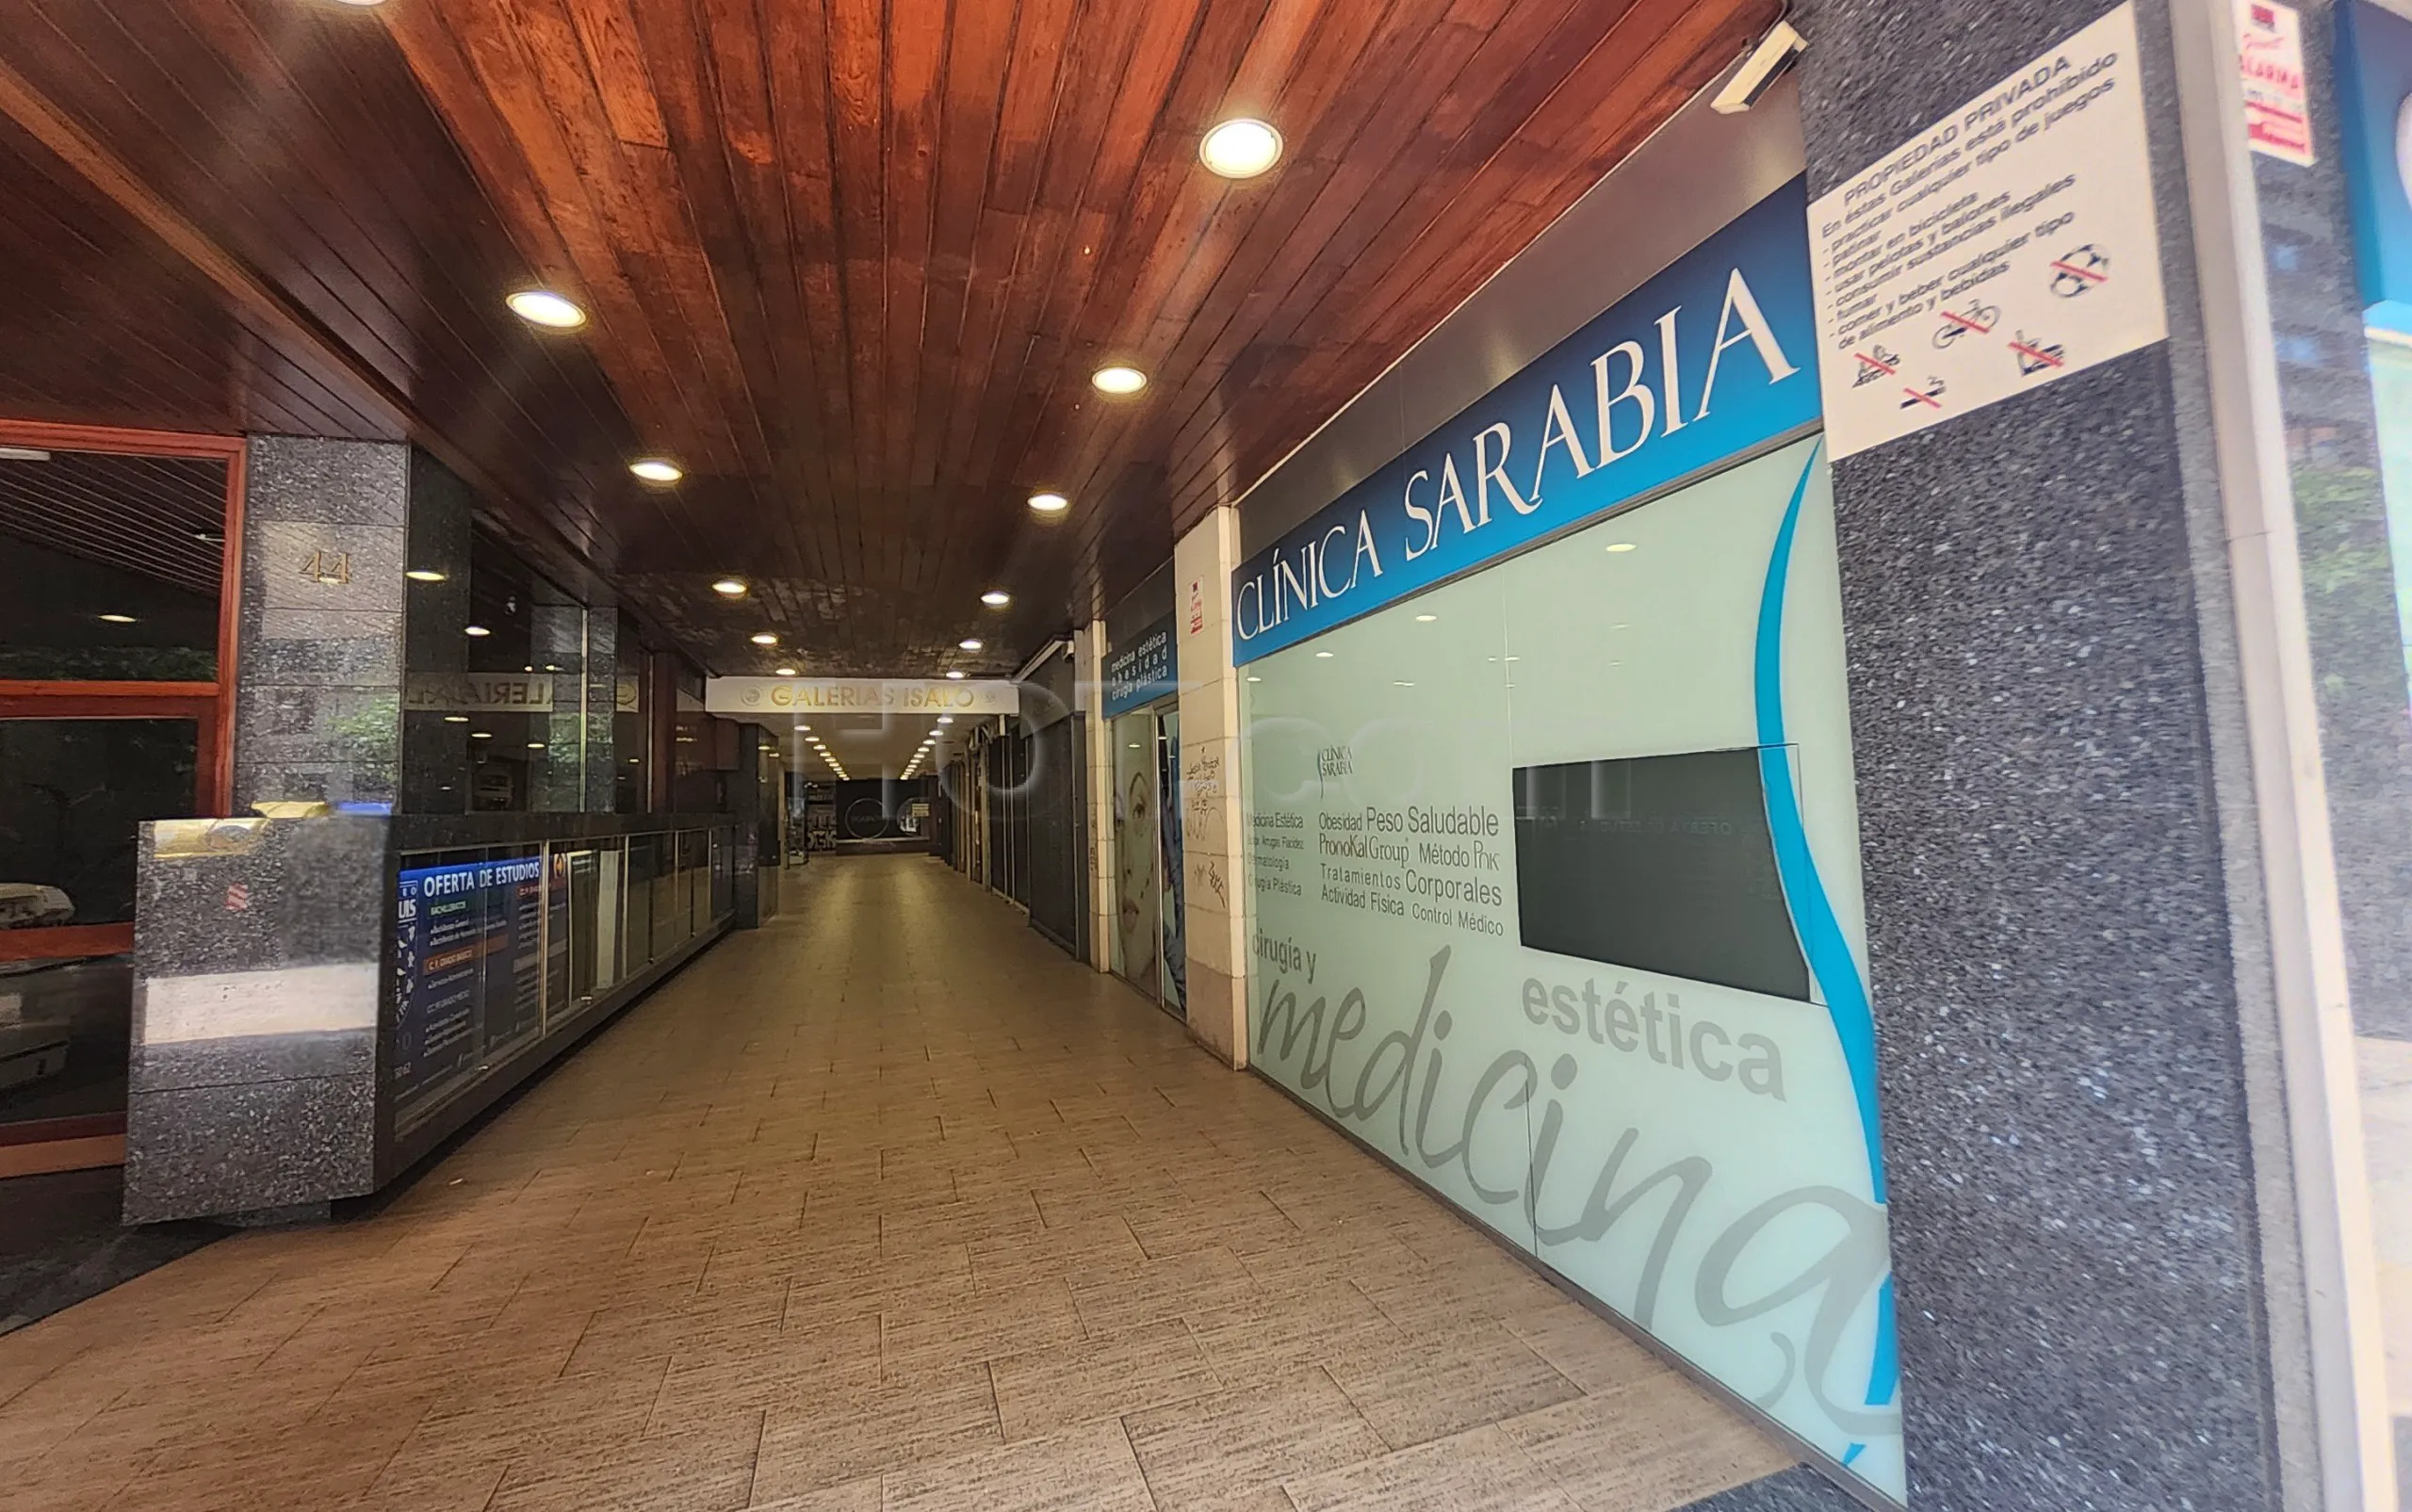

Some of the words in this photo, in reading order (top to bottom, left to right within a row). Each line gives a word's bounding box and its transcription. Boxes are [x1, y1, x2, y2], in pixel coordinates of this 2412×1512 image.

[1822, 220, 1841, 238] En
[1965, 117, 2006, 152] está
[2012, 53, 2118, 128] prohibido
[1845, 124, 1959, 206] PROPIEDAD
[1964, 57, 2071, 131] PRIVADA
[1832, 207, 1894, 253] practicar
[1897, 161, 1972, 213] cualquier
[1976, 139, 2012, 167] tipo
[2015, 122, 2039, 143] de
[2044, 78, 2115, 132] juegos
[1833, 245, 1883, 278] montar
[1886, 233, 1906, 250] en
[1909, 192, 1978, 236] bicicleta
[1833, 230, 1882, 268] patinar
[1834, 269, 1866, 293] usar
[1869, 238, 1924, 277] pelotas
[1928, 230, 1938, 245] y
[1941, 190, 2011, 236] balones
[1835, 264, 1903, 307] consumir
[1907, 216, 1997, 270] sustancias
[2000, 174, 2076, 221] ilegales
[1838, 305, 1882, 335] comer
[1885, 301, 1896, 316] y
[1899, 275, 1945, 305] beber
[1948, 233, 2031, 281] cualquier
[2034, 211, 2075, 237] tipo
[1837, 293, 1878, 320] fumar
[1838, 335, 1856, 350] de
[1859, 302, 1924, 341] alimento
[1926, 295, 1938, 312] y
[1941, 261, 2010, 301] bebidas
[1236, 509, 1382, 641] CLÍNICA
[1405, 268, 1801, 561] SARABIA
[300, 550, 350, 584] 44
[1112, 650, 1135, 673] medicina
[1138, 631, 1166, 657] estética
[1136, 665, 1167, 692] plástica
[771, 685, 895, 707] GALERIAS
[903, 687, 975, 707] ISALO
[1275, 812, 1304, 828] Estética
[1319, 811, 1362, 831] Obesidad
[1367, 806, 1404, 833] Peso
[1408, 805, 1499, 837] Saludable
[424, 871, 475, 898] OFERTA
[480, 869, 493, 888] DE
[496, 862, 540, 886] ESTUDIOS
[1420, 842, 1470, 868] Método
[1320, 862, 1401, 890] Tratamientos
[1406, 869, 1503, 906] Corporales
[1321, 883, 1365, 909] Actividad
[1371, 891, 1405, 917] Física
[1412, 902, 1452, 927] Control
[1459, 910, 1504, 936] Médico
[1253, 927, 1302, 974] cirugía
[1306, 951, 1316, 984] y
[1522, 976, 1787, 1103] estética
[1259, 945, 1902, 1436] medicina
